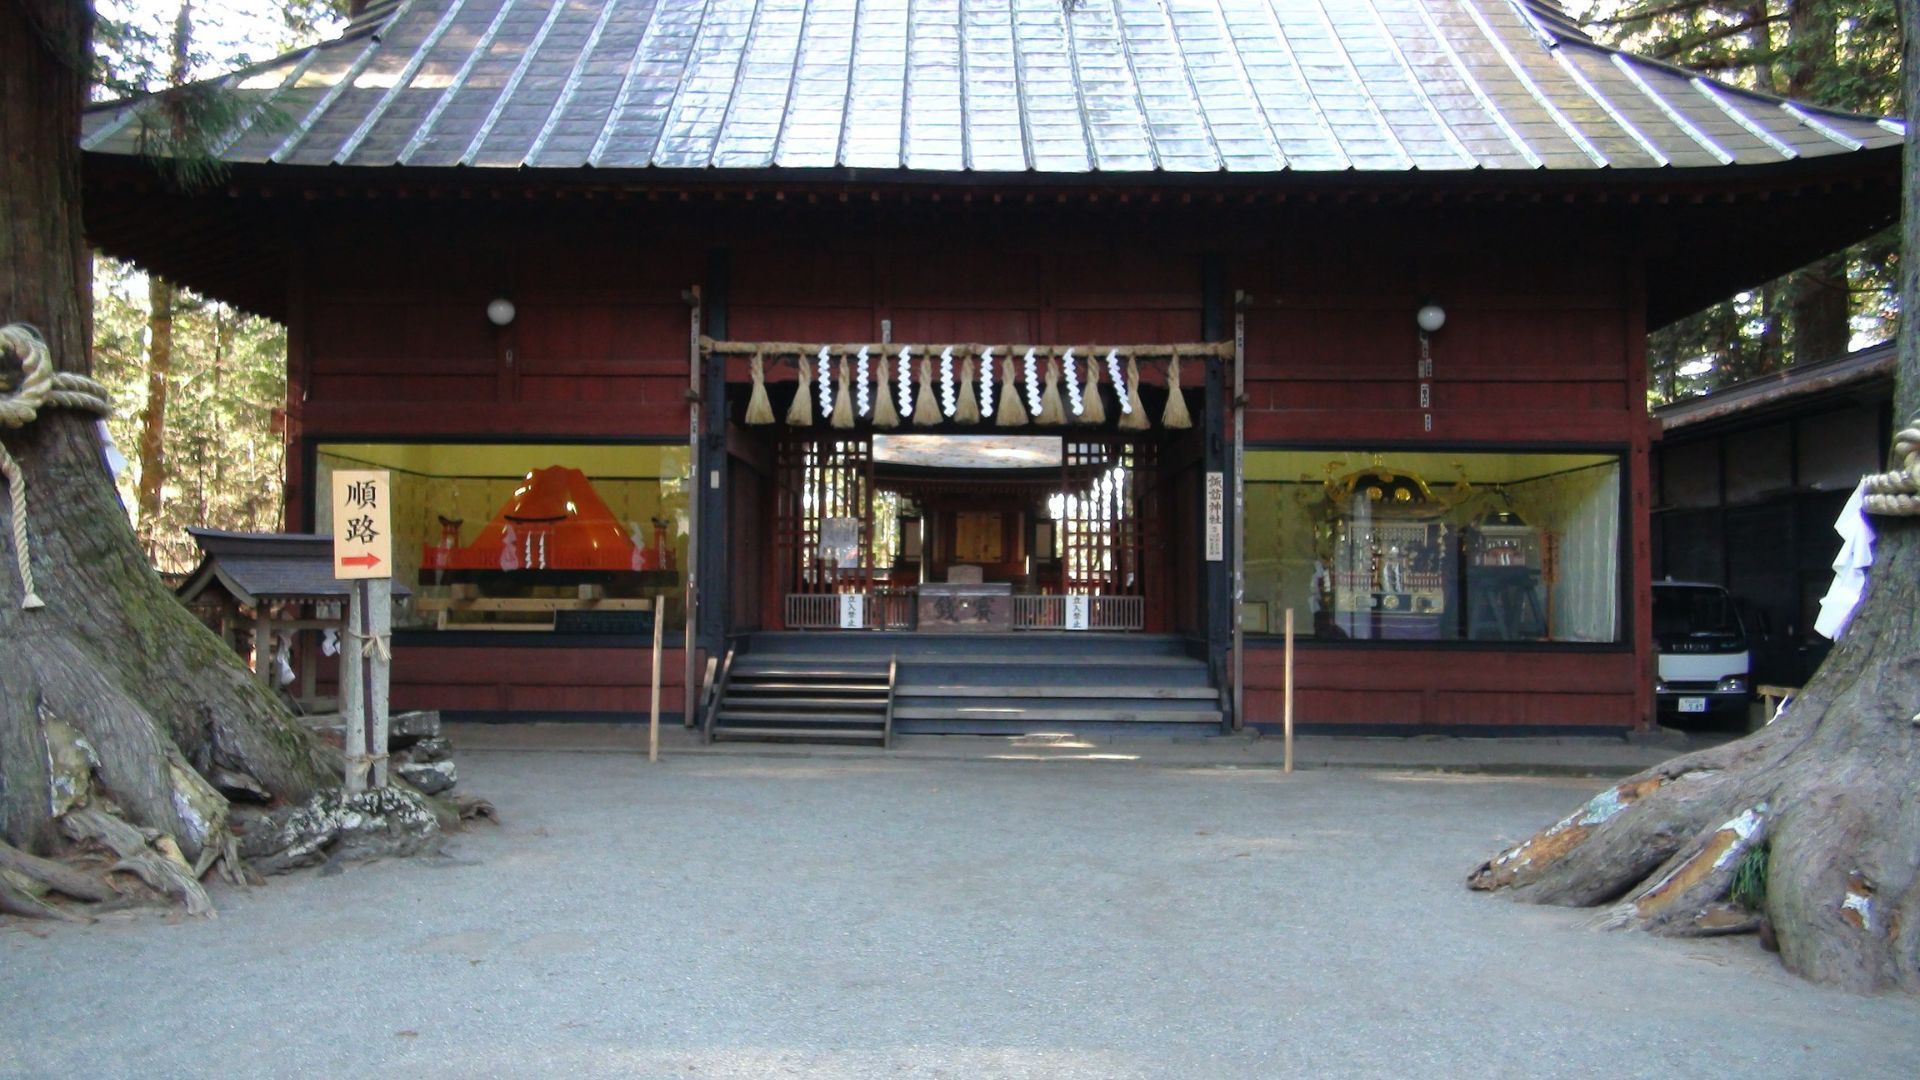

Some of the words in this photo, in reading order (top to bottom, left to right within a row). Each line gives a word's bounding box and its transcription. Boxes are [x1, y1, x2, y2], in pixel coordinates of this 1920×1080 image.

[344, 480, 380, 545] 順路
[846, 595, 857, 627] 立入禁止
[1072, 597, 1082, 628] 立入禁止
